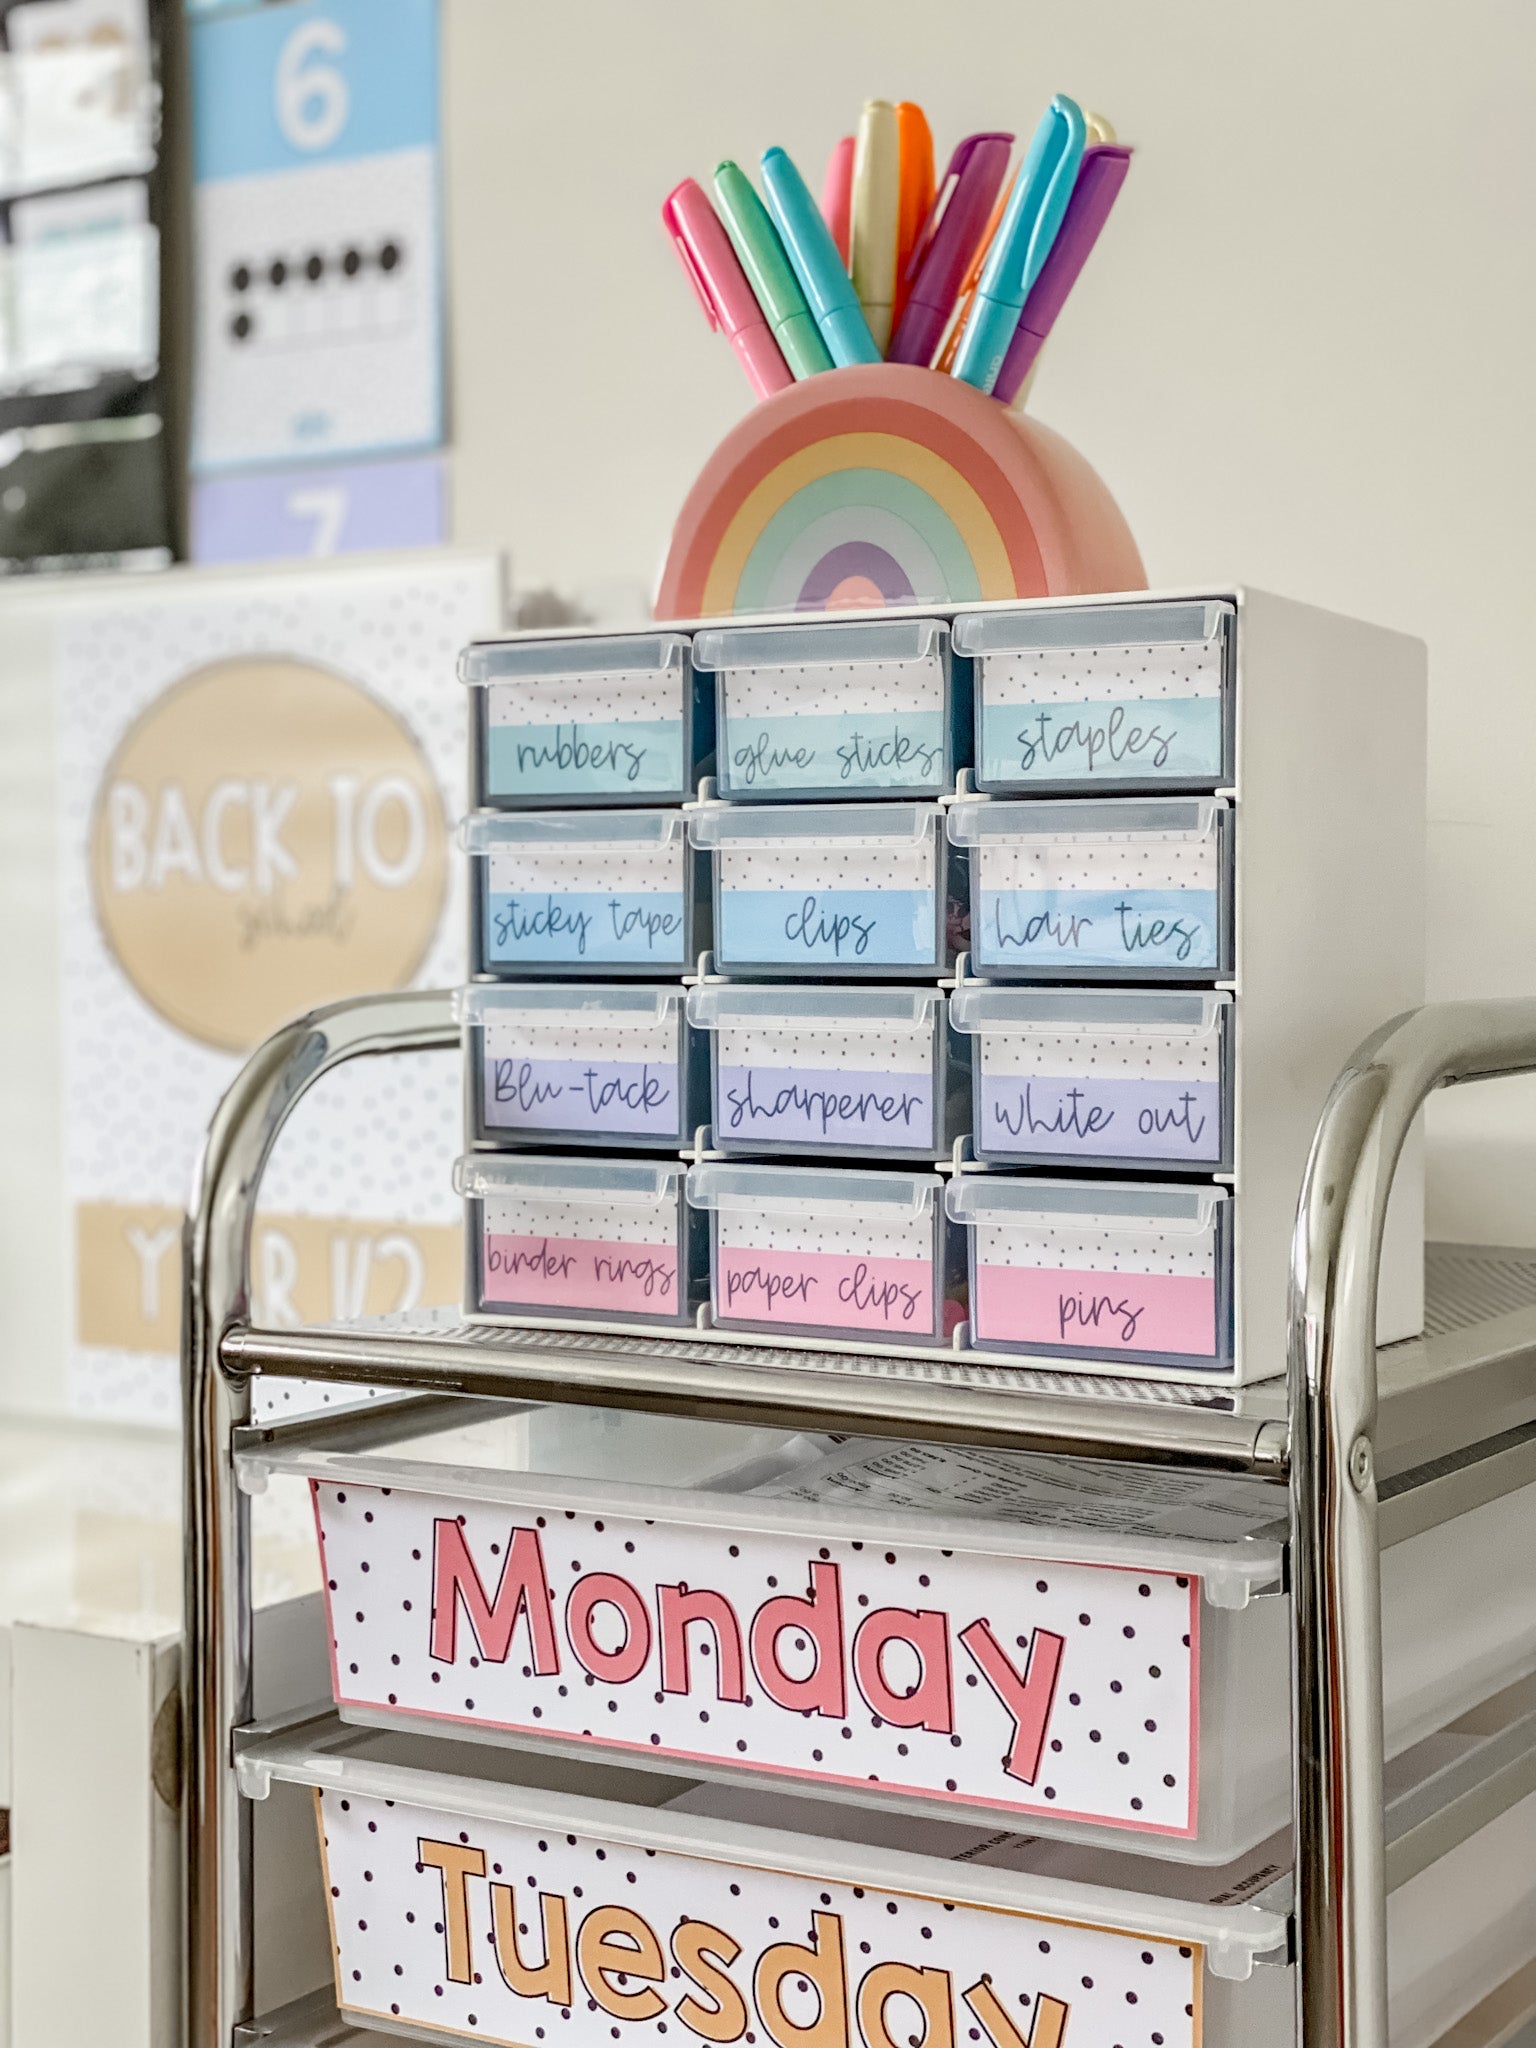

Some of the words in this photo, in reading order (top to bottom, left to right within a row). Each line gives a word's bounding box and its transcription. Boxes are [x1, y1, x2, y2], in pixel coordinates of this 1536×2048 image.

[275, 19, 348, 151] 6
[286, 487, 348, 559] 7
[517, 724, 647, 781] rubbers
[733, 732, 816, 785] glue
[835, 725, 943, 779] sticks
[1016, 706, 1177, 772] staples
[108, 778, 300, 894] BACK
[327, 772, 427, 887] TO
[493, 894, 592, 955] sticky
[608, 898, 683, 949] tape
[784, 896, 876, 956] clips
[996, 897, 1093, 948] hair
[1114, 900, 1201, 961] ties
[494, 1058, 669, 1114] Blu-tack
[726, 1070, 923, 1134] sharpener
[995, 1082, 1114, 1139] white
[1137, 1091, 1206, 1143] out
[122, 1222, 302, 1327] YR
[486, 1235, 577, 1279] binder
[593, 1255, 677, 1297] rings
[726, 1266, 818, 1311] paper
[837, 1262, 922, 1320] clips
[1059, 1291, 1145, 1342] pins
[429, 1517, 1066, 1787] Monday
